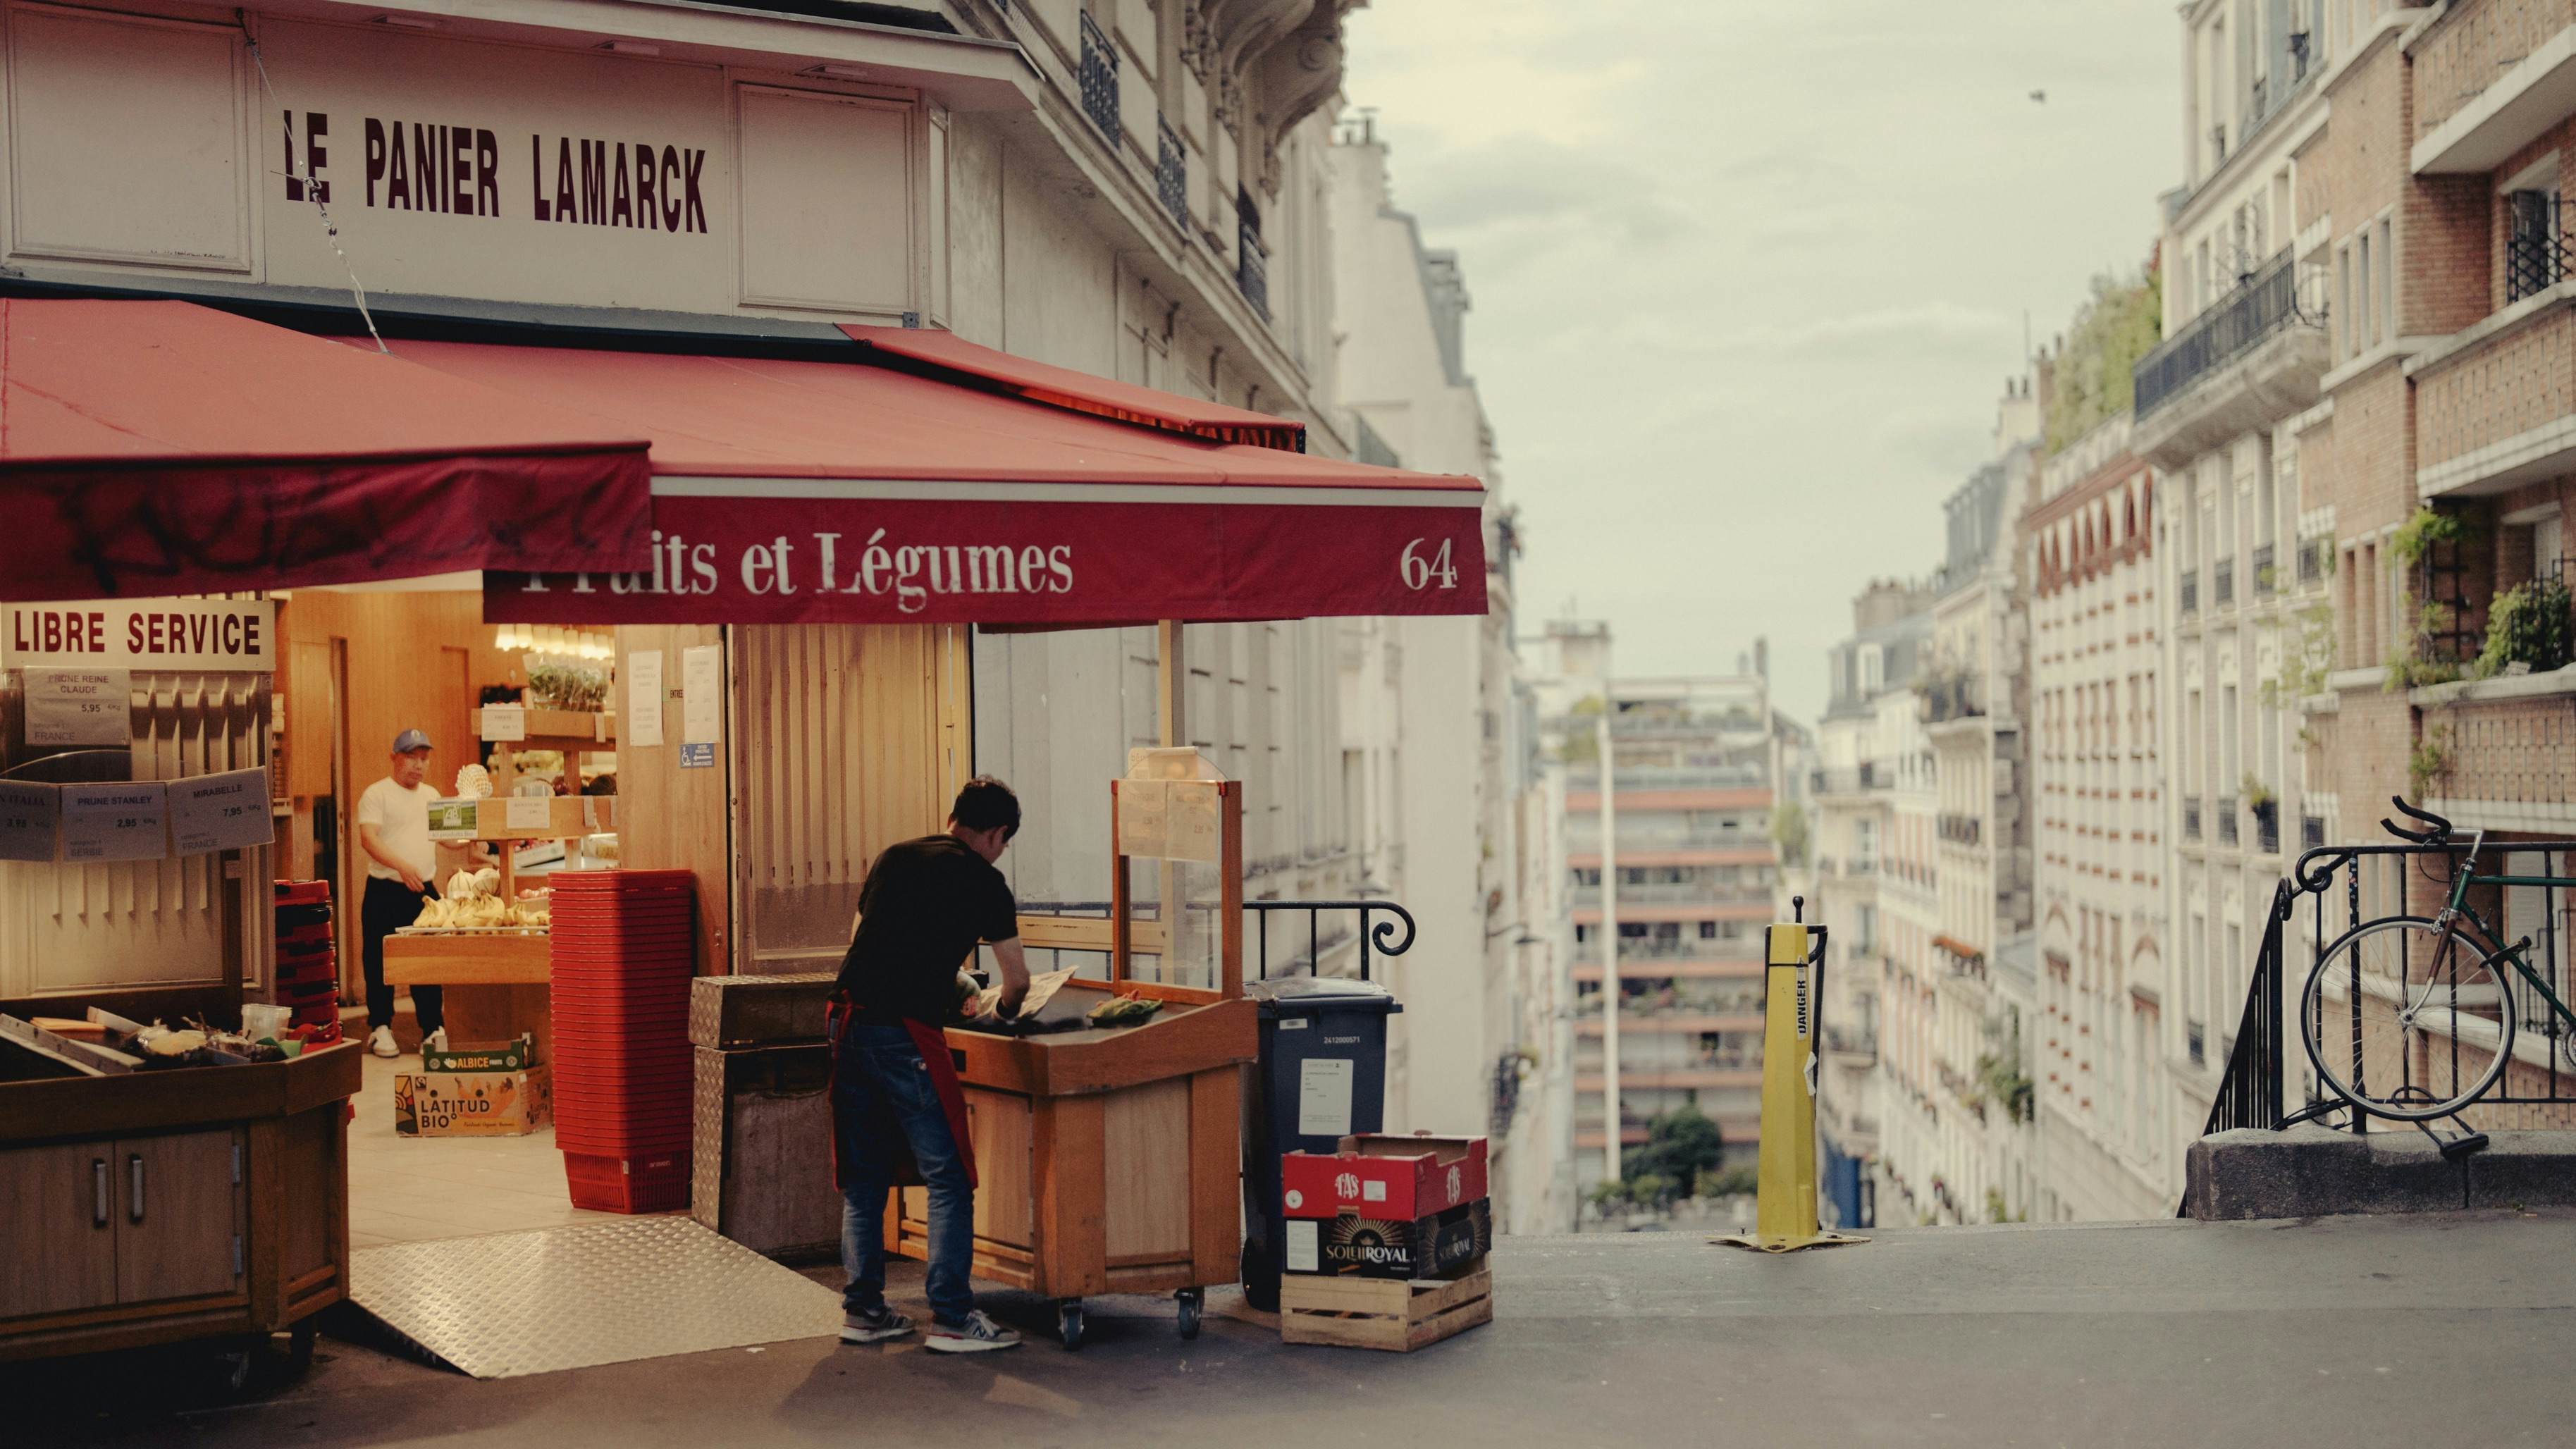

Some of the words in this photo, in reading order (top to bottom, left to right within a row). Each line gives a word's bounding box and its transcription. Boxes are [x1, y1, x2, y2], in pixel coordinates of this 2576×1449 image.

[284, 110, 330, 203] LE
[365, 118, 499, 217] PANIER
[533, 135, 708, 233] LAMARCK
[522, 530, 718, 595] its
[741, 535, 798, 595] et
[813, 527, 1073, 612] Légumes
[1400, 538, 1458, 590] 64
[15, 611, 105, 653] LIBRE
[127, 612, 260, 655] SERVICE
[81, 705, 101, 713] 5,95
[35, 732, 75, 741] FRANCE
[193, 784, 242, 798] MIRABELLE
[112, 796, 152, 805] STANLEY
[1797, 980, 1806, 1033] DANGER
[457, 1057, 489, 1068] ALBICE
[421, 1100, 490, 1114] LATITUD
